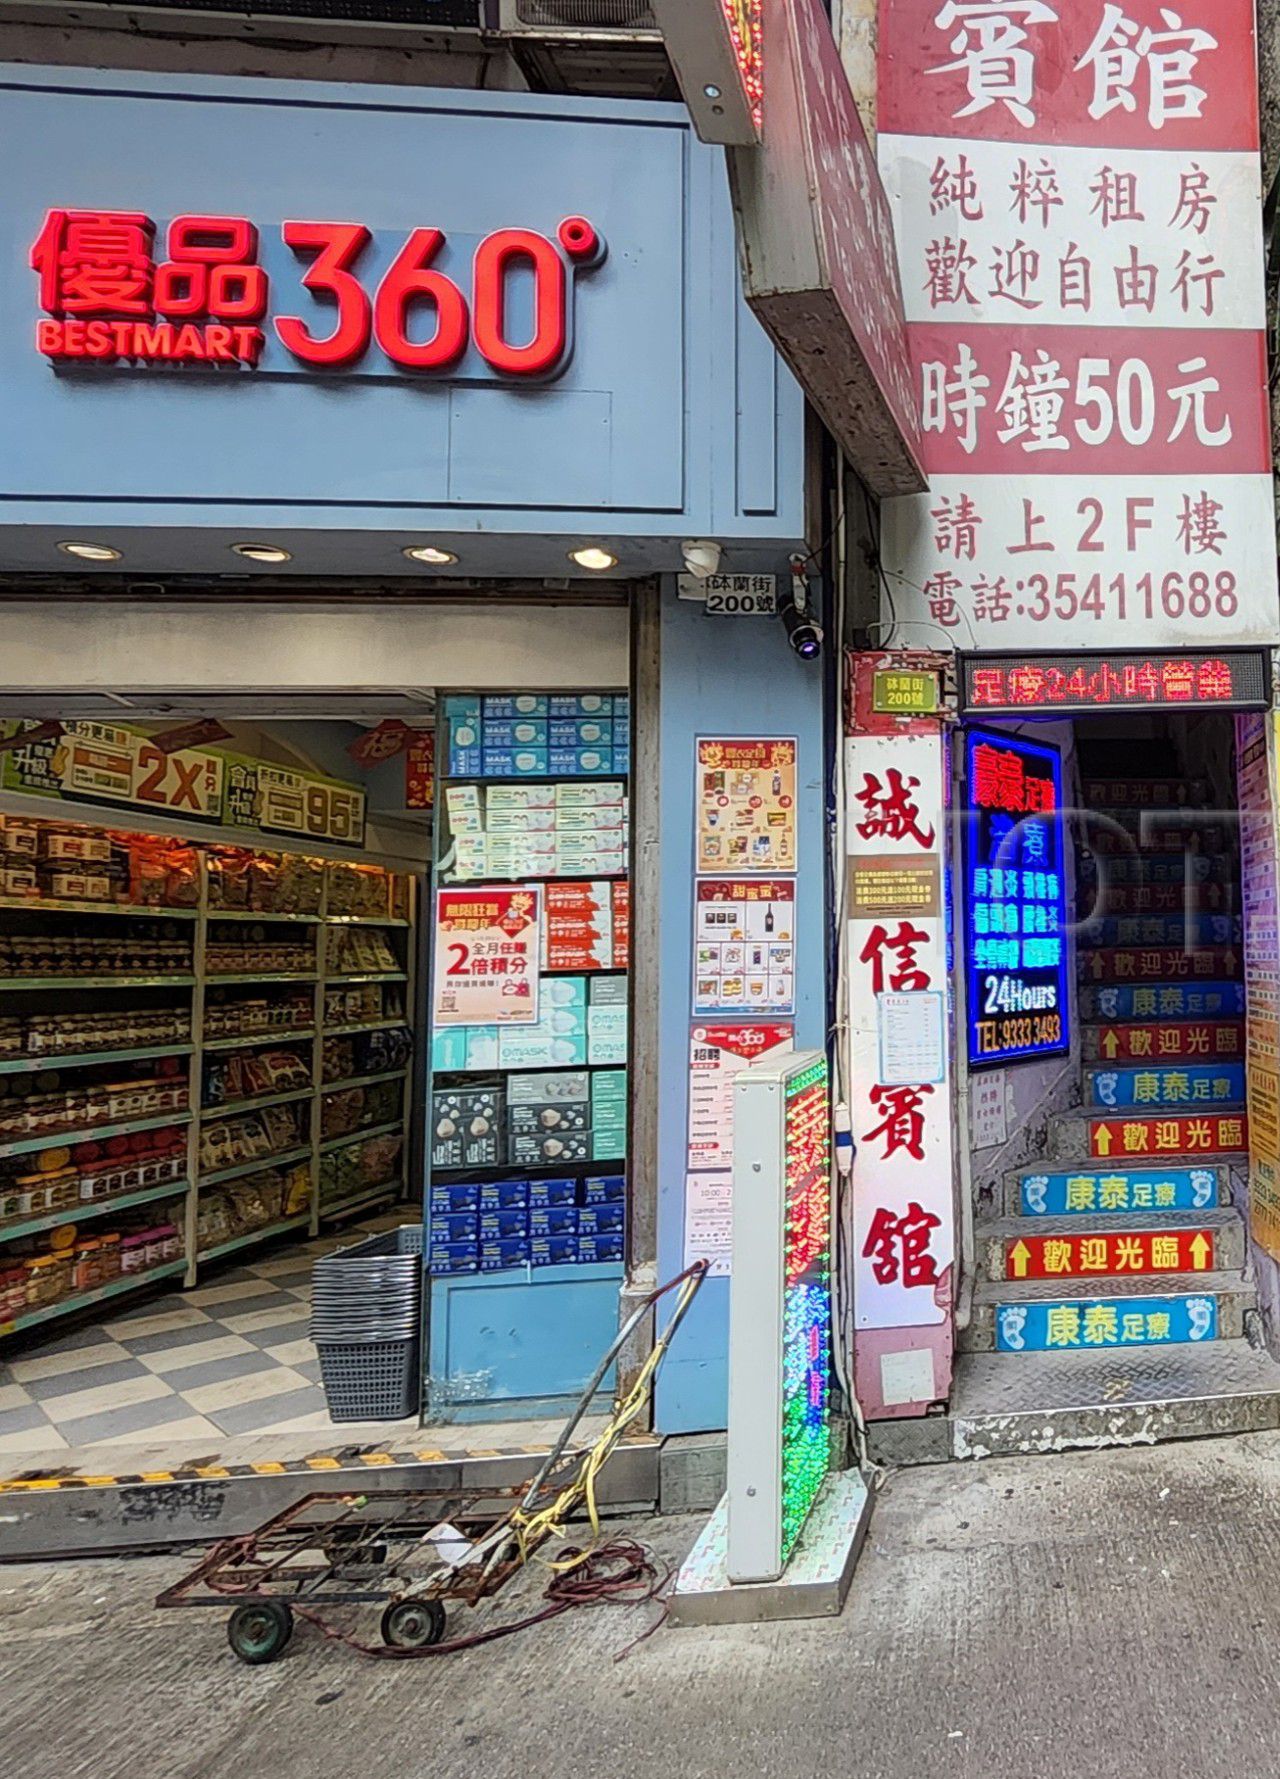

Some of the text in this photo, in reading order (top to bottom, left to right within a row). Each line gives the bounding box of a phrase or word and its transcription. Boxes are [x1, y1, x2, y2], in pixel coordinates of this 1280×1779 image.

[923, 0, 1219, 128] 賓館
[929, 157, 1218, 236] 純粹租房
[29, 207, 270, 319] 優品
[921, 237, 1225, 315] 歡迎自由行
[37, 319, 267, 369] BESTMART
[920, 345, 1233, 455] 時鐘50元
[931, 492, 1228, 562] 請上2F樓
[708, 593, 774, 613] 200號
[922, 569, 1239, 628] 電話:35411688
[886, 691, 925, 706] 200號
[971, 658, 1233, 706] 足療24小時營業
[136, 745, 204, 811] 2X
[307, 786, 351, 838] 95
[1131, 985, 1223, 1017] 康泰足療
[1128, 1024, 1238, 1057] 歡迎光臨
[1132, 1073, 1232, 1102] 康泰足療
[1122, 1117, 1243, 1152] 歡迎光臨
[1065, 1174, 1176, 1211] 康泰足療
[1042, 1235, 1180, 1273] 歡迎光臨
[1045, 1304, 1171, 1346] 康泰足療
